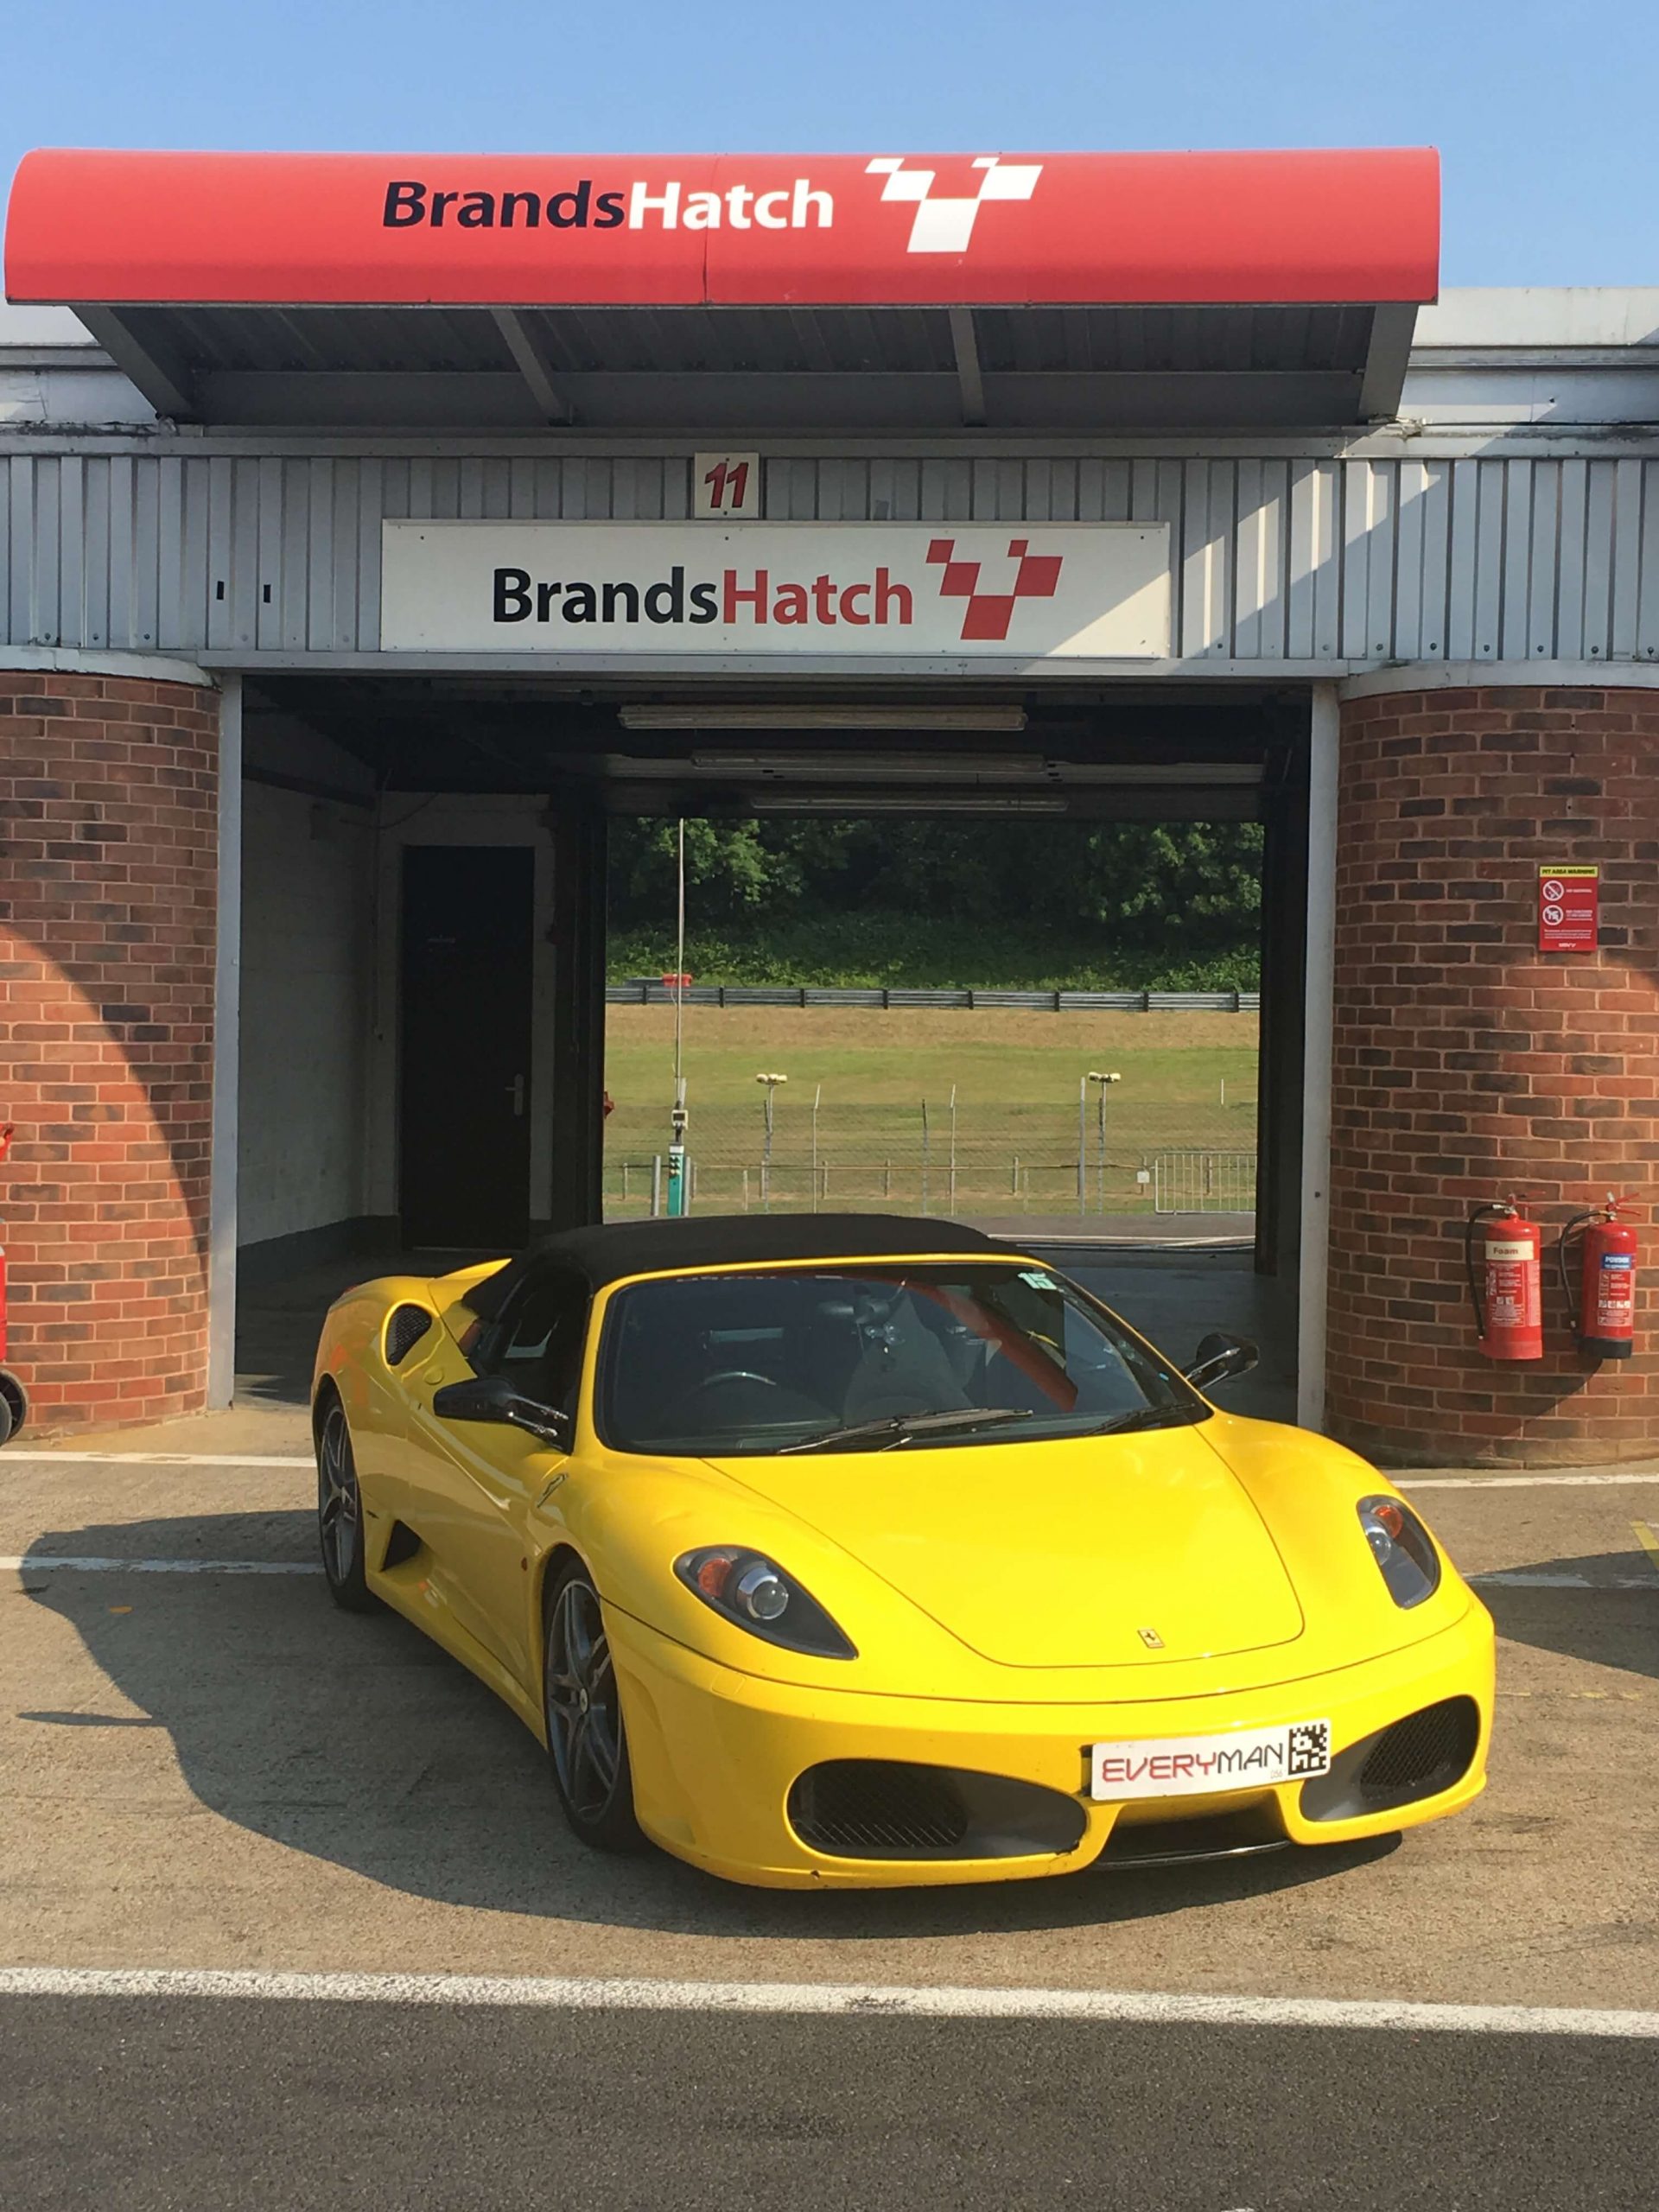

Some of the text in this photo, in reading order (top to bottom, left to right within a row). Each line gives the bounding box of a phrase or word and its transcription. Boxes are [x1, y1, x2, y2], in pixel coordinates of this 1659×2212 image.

[383, 179, 834, 229] BrandsHatch
[704, 462, 749, 509] 11
[493, 566, 912, 626] BrandsHatch
[1017, 1272, 1057, 1290] 15
[1102, 1742, 1283, 1783] EVERYMAN
